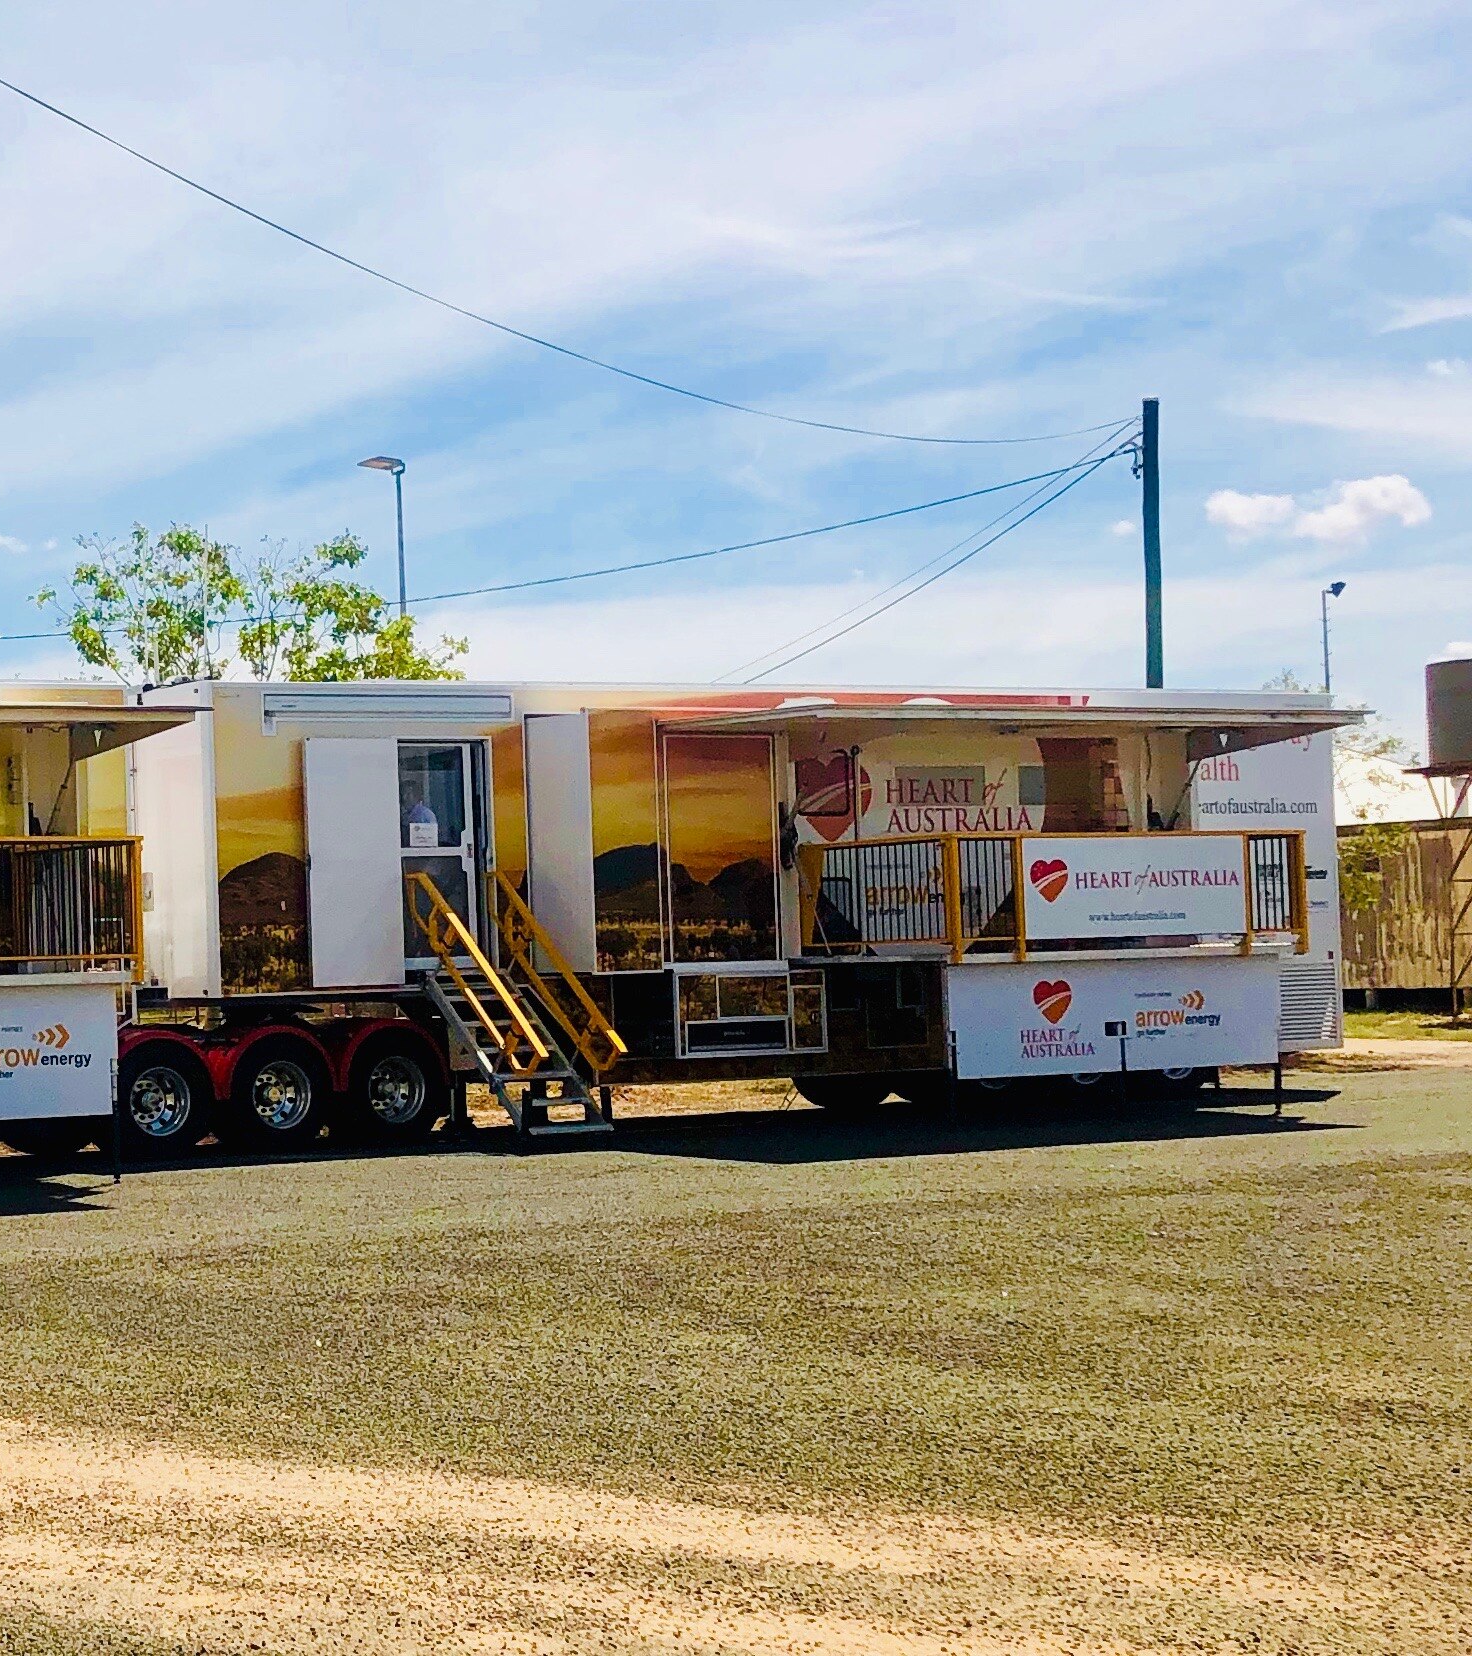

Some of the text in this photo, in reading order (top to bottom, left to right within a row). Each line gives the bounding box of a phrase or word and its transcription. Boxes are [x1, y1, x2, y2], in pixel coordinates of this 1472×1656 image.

[1200, 755, 1240, 782] alth
[884, 768, 1007, 815] HEART of
[1199, 798, 1318, 815] artofaustralia.com
[886, 806, 1033, 834] AUSTRALIA
[1075, 871, 1132, 889] HEART
[1134, 864, 1151, 895] of
[1149, 869, 1240, 888] AUSTRALIA
[1135, 1009, 1221, 1027] arrow energy
[1020, 1027, 1066, 1044] HEART
[1021, 1042, 1096, 1059] AUSTRALIA
[40, 1053, 92, 1069] energy
